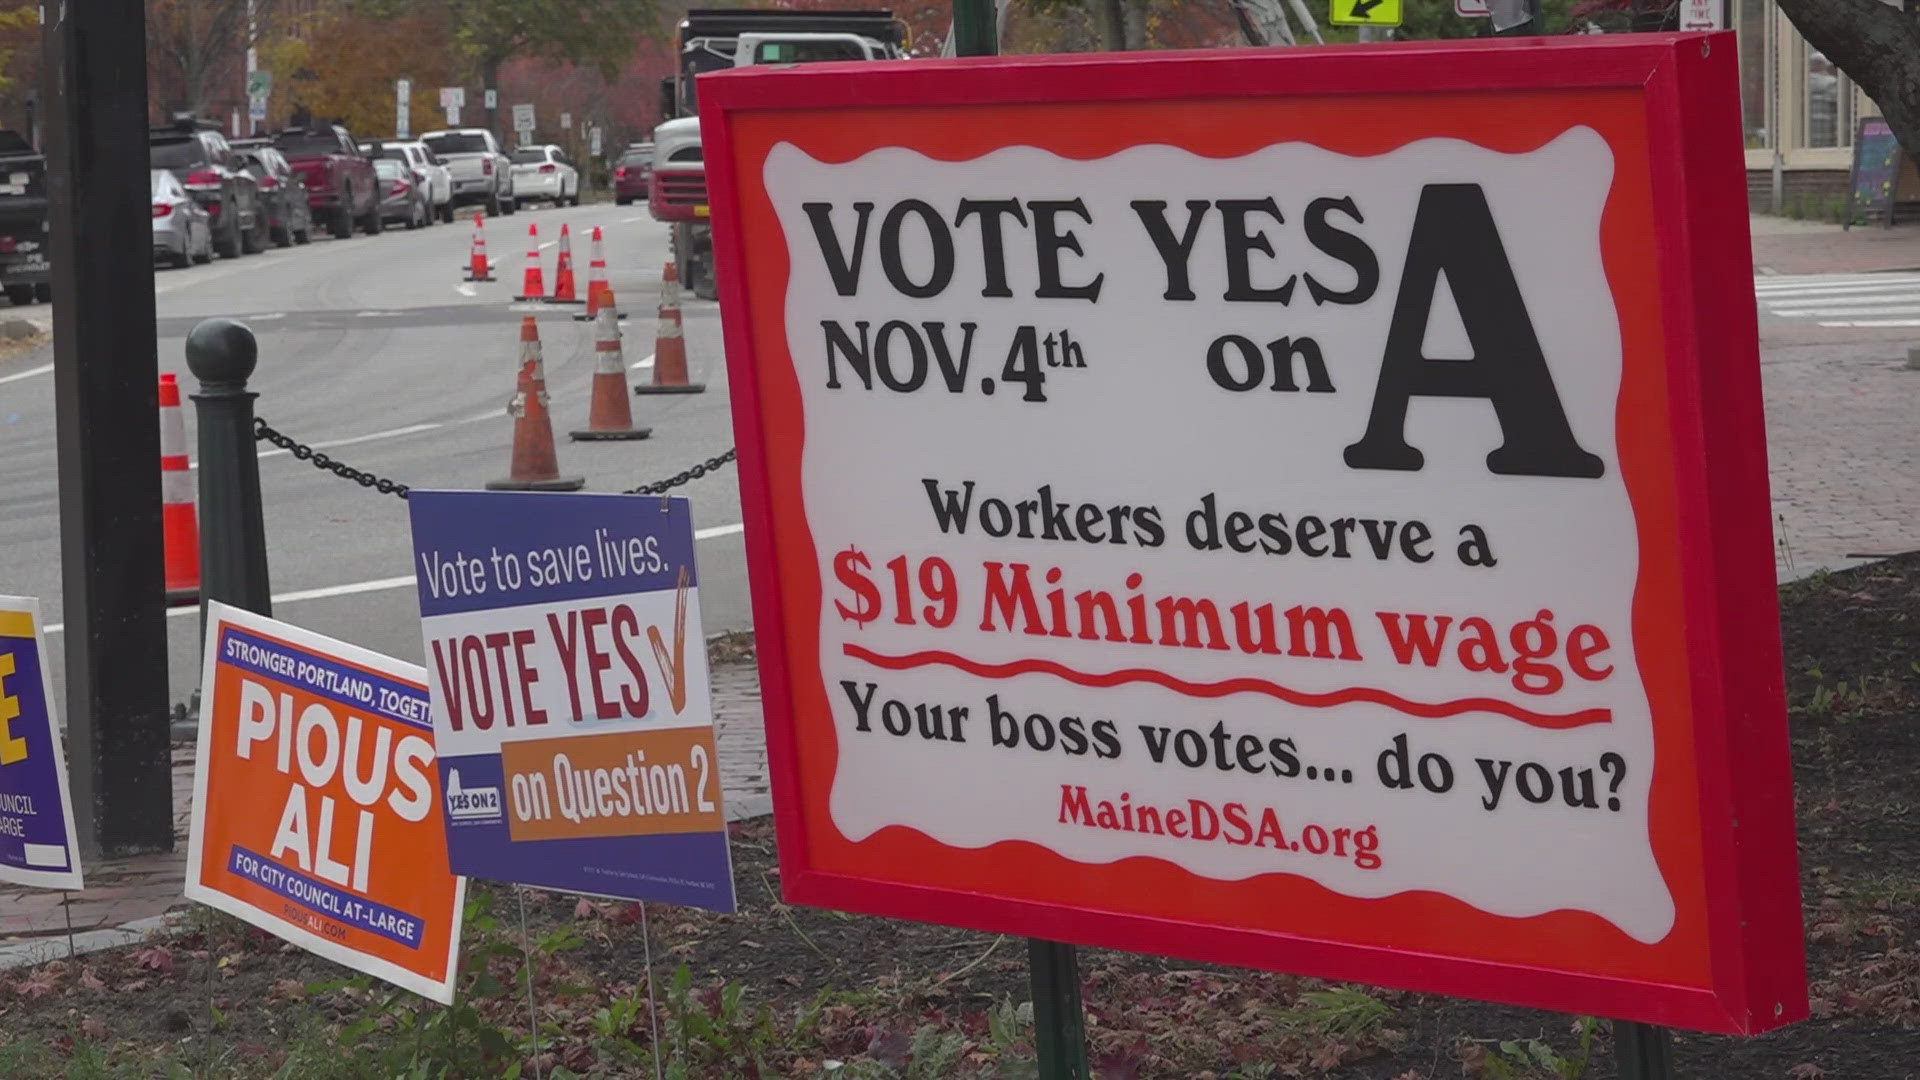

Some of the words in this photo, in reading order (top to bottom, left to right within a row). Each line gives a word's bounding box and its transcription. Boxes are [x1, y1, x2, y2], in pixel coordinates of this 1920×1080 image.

[802, 196, 1104, 305] VOTE
[1130, 195, 1381, 307] YES
[1206, 333, 1337, 394] on
[1343, 182, 1605, 480] A
[422, 551, 486, 599] Vote
[491, 547, 521, 592] to
[527, 544, 592, 588] save
[595, 528, 669, 579] lives.
[921, 478, 1166, 548] Workers
[1185, 492, 1435, 565] deserve
[1456, 523, 1498, 569] a
[832, 543, 959, 631] $19
[979, 560, 1364, 662] Minimum
[1375, 608, 1615, 697] wage
[227, 637, 295, 679] STRONGER
[297, 660, 376, 707] PORTLAND,
[431, 629, 548, 732] VOTE
[546, 604, 650, 722] YES
[236, 678, 437, 823] PIOUS
[512, 771, 551, 822] on
[553, 749, 689, 825] Question
[690, 744, 715, 814] 2
[839, 679, 970, 743] Your
[985, 693, 1122, 760] boss
[1137, 719, 1353, 785] votes...
[1376, 732, 1455, 794] do
[1474, 751, 1627, 813] you?
[0, 794, 37, 815] UNCIL
[270, 782, 374, 894] ALI
[449, 794, 470, 811] YES
[471, 793, 488, 809] ON
[490, 792, 497, 808] 2
[1057, 783, 1383, 871] MaineDSA.org
[236, 853, 259, 878] FOR
[260, 864, 285, 889] CITY
[287, 876, 341, 914] COUNCIL
[343, 900, 415, 941] AT-LARGE
